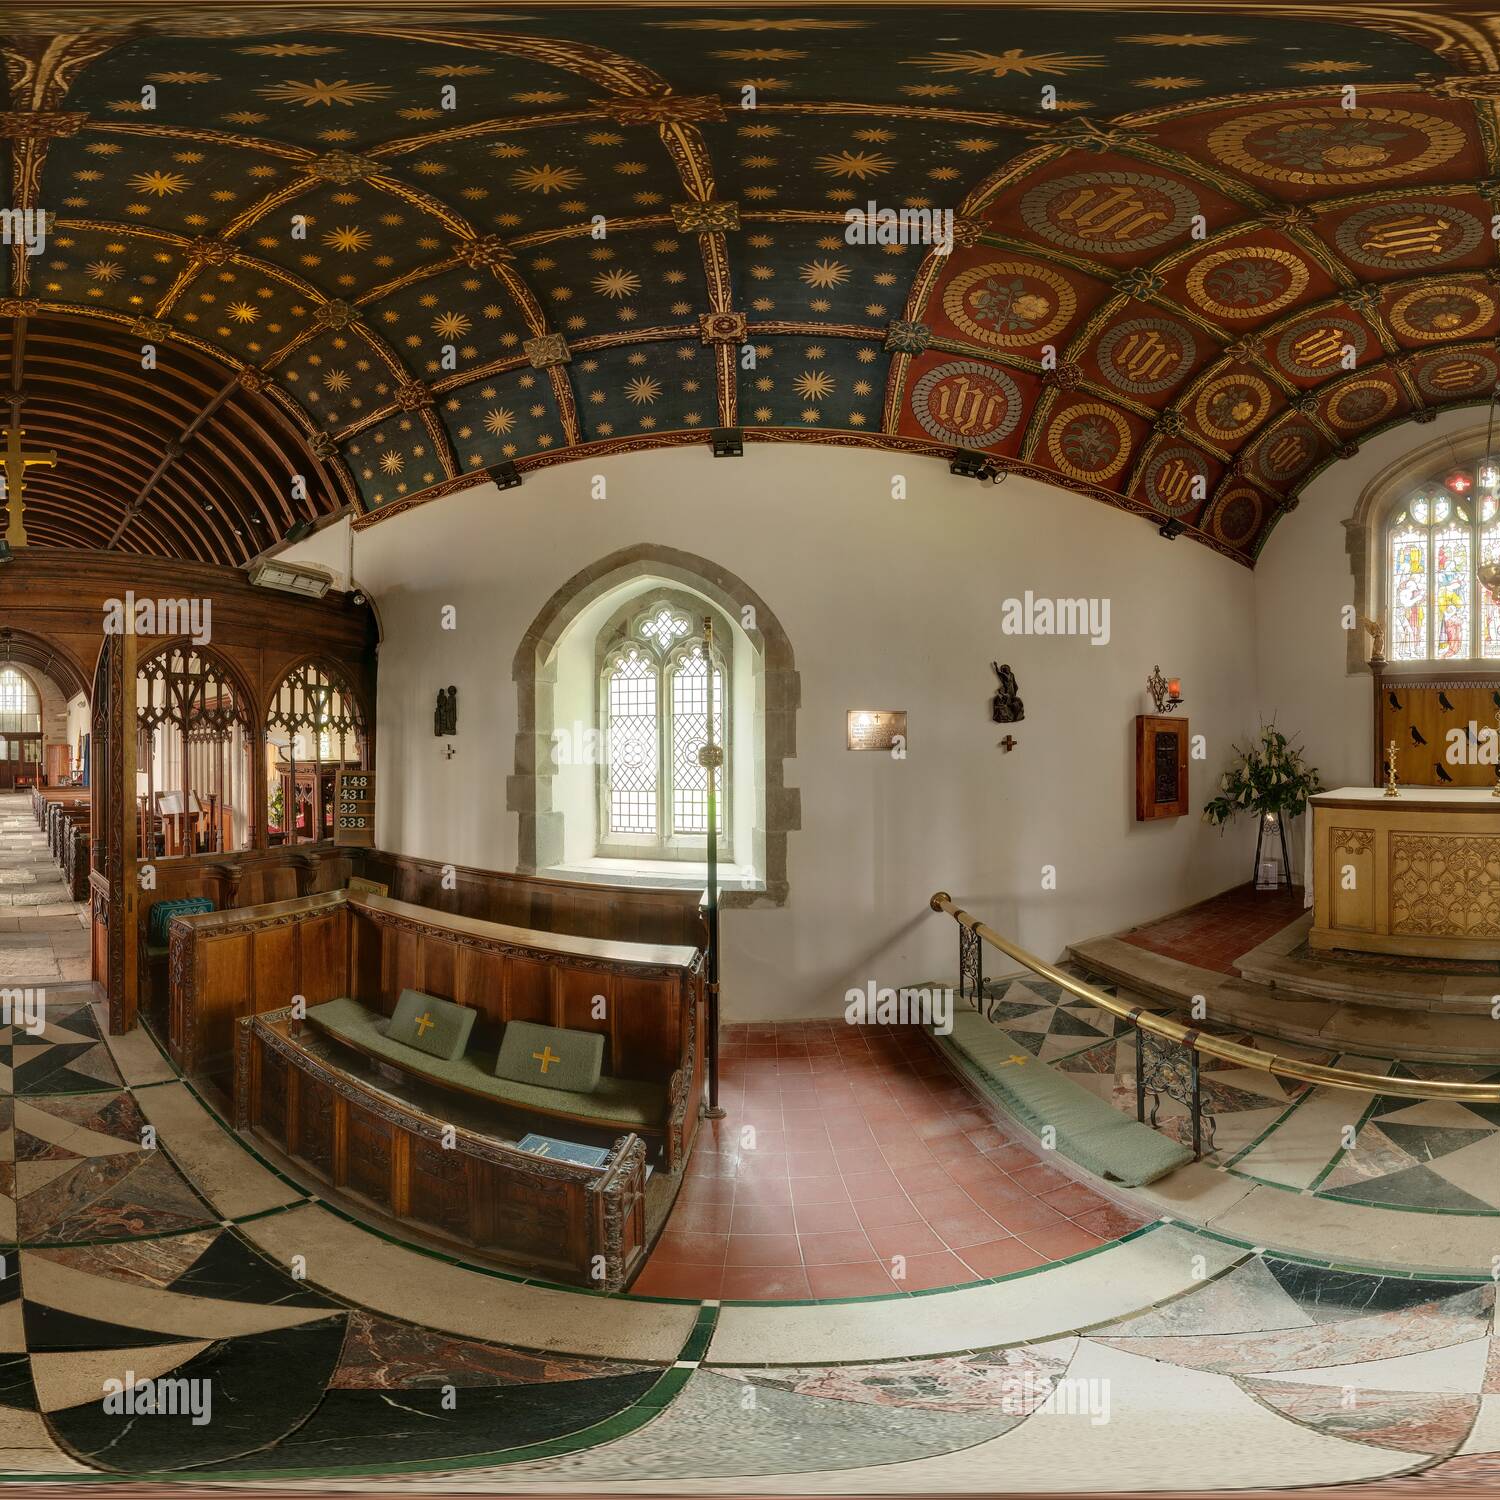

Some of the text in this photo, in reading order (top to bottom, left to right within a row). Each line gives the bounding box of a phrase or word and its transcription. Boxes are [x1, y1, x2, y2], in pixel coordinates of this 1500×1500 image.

[342, 776, 368, 787] 148
[340, 789, 364, 800] 431
[340, 803, 357, 814] 22
[339, 817, 365, 828] 338
